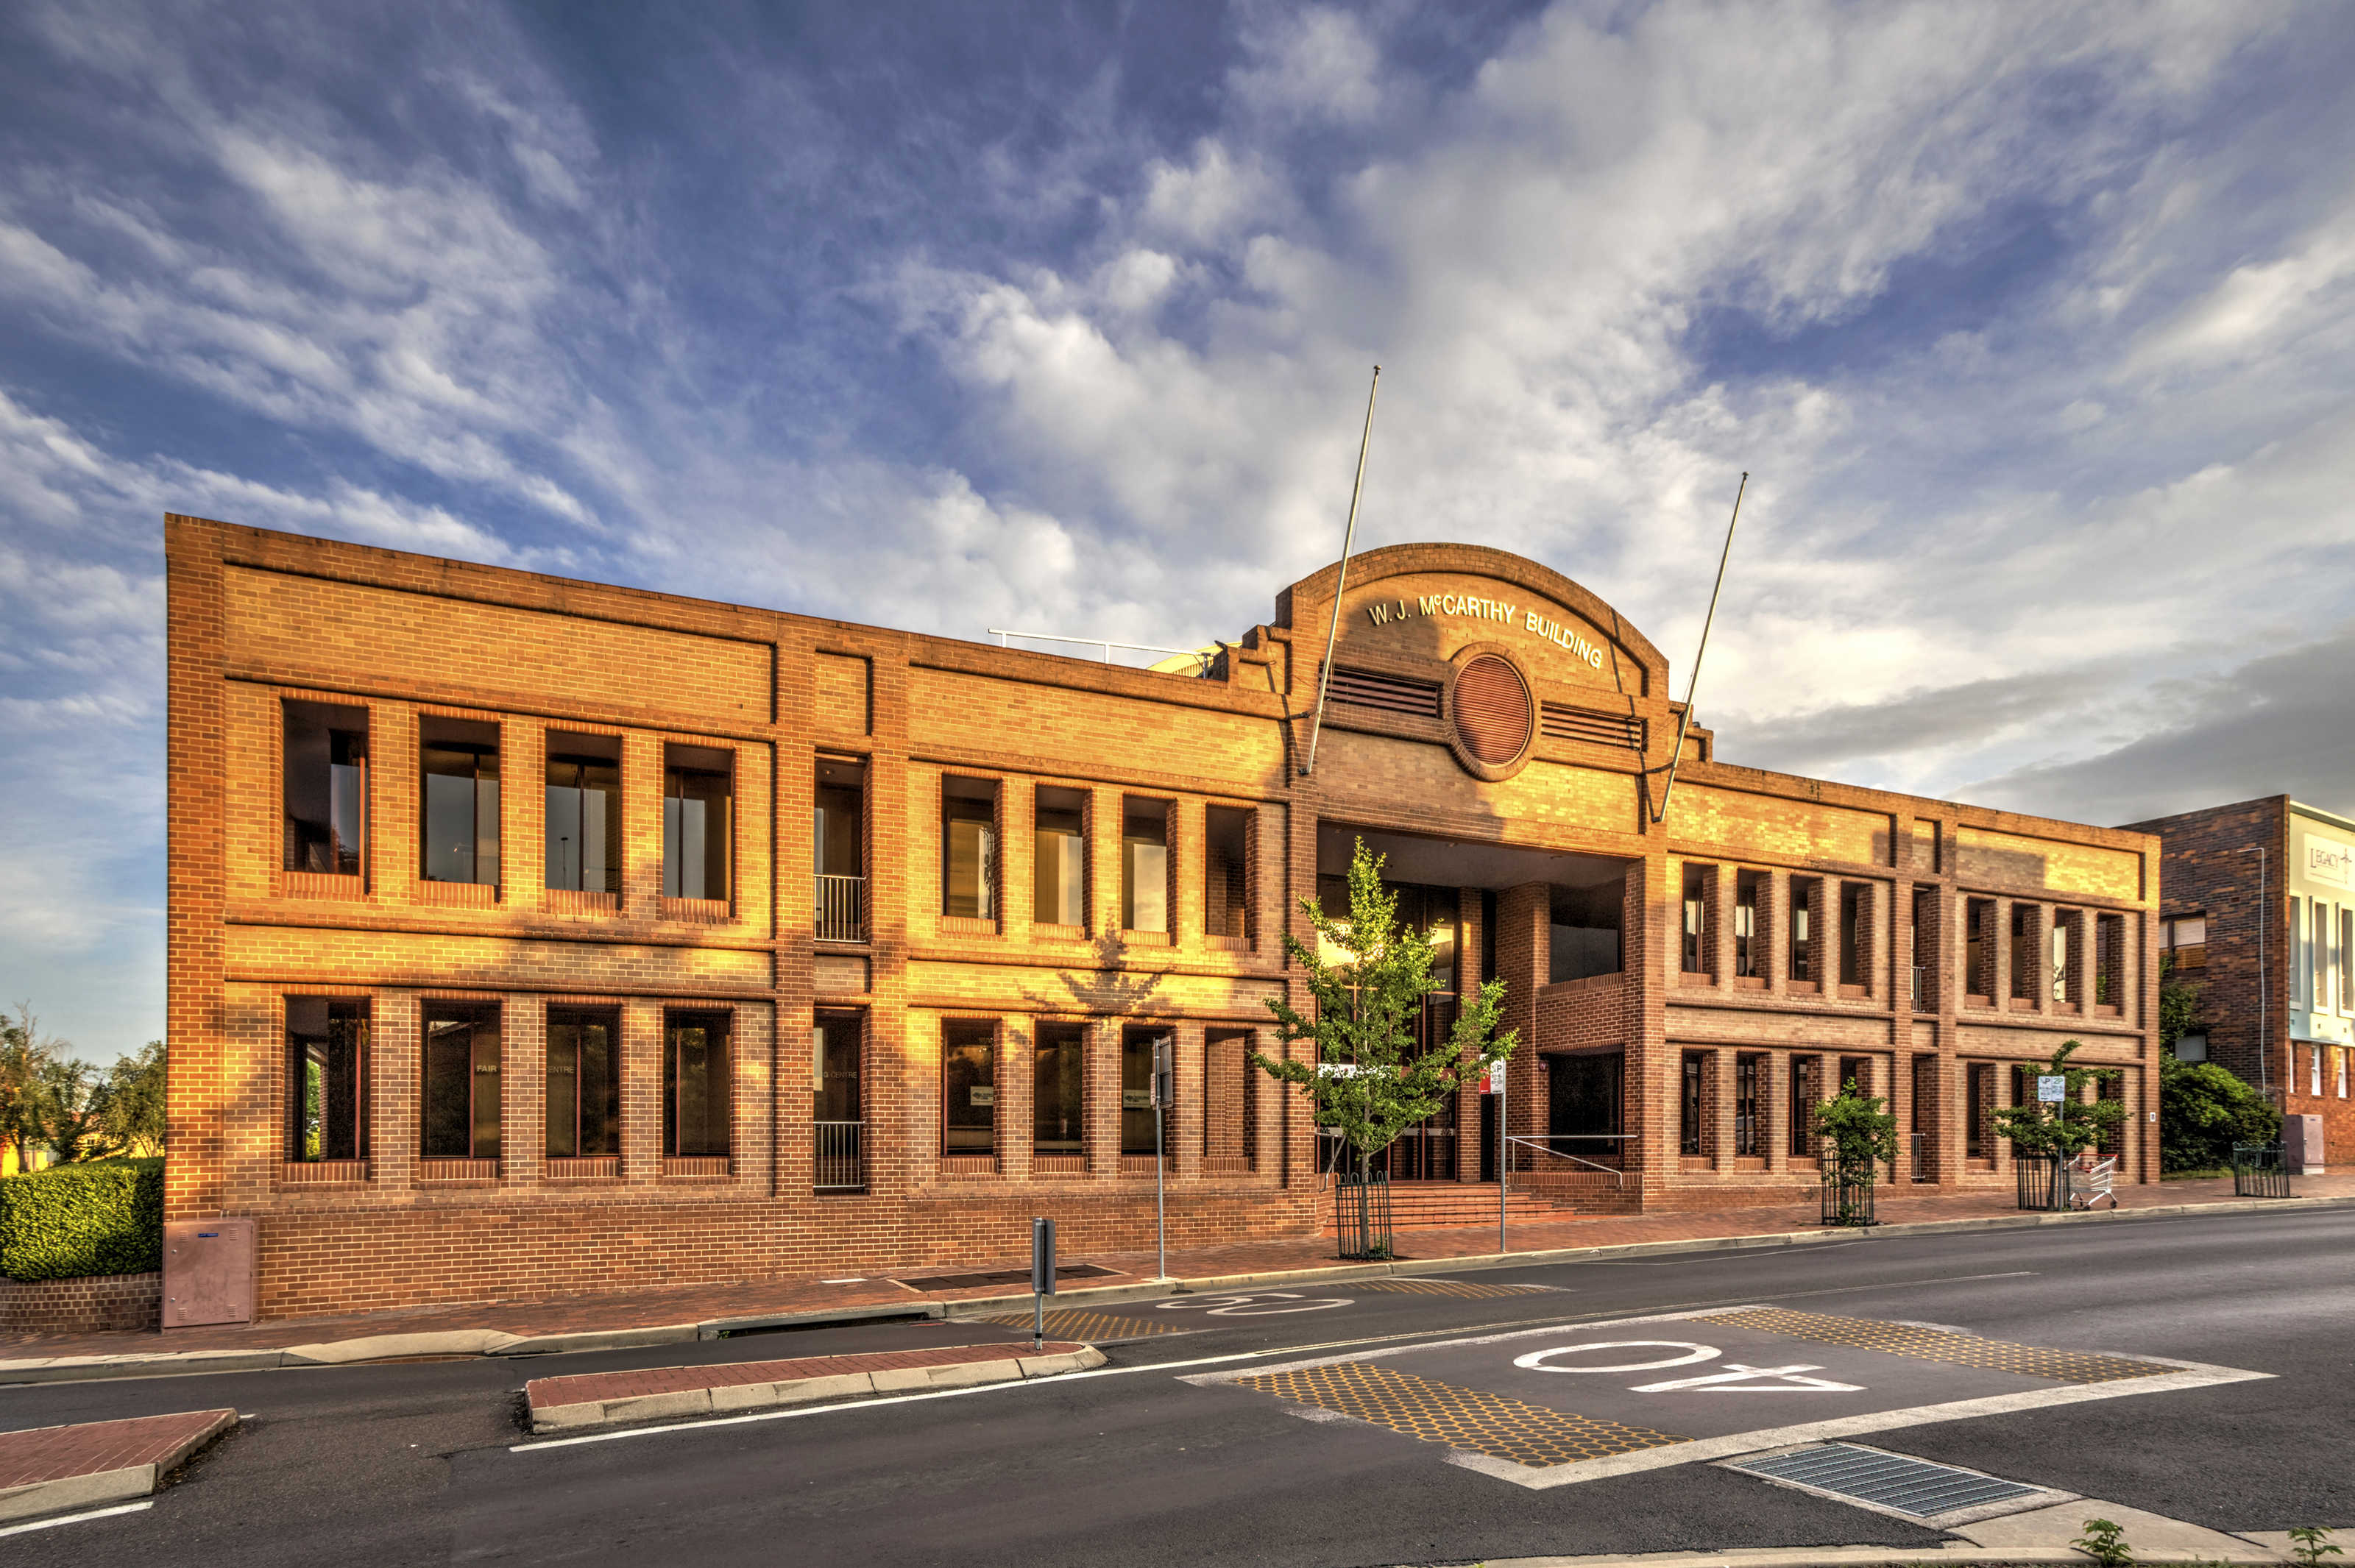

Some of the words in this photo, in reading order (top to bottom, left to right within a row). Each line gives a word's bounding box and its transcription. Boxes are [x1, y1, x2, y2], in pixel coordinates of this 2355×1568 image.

[1368, 603, 1392, 625] W.
[1395, 600, 1411, 620] J.
[1525, 611, 1602, 670] BUILDING
[546, 1065, 574, 1074] ENTRE
[1513, 1341, 1869, 1392] 40
